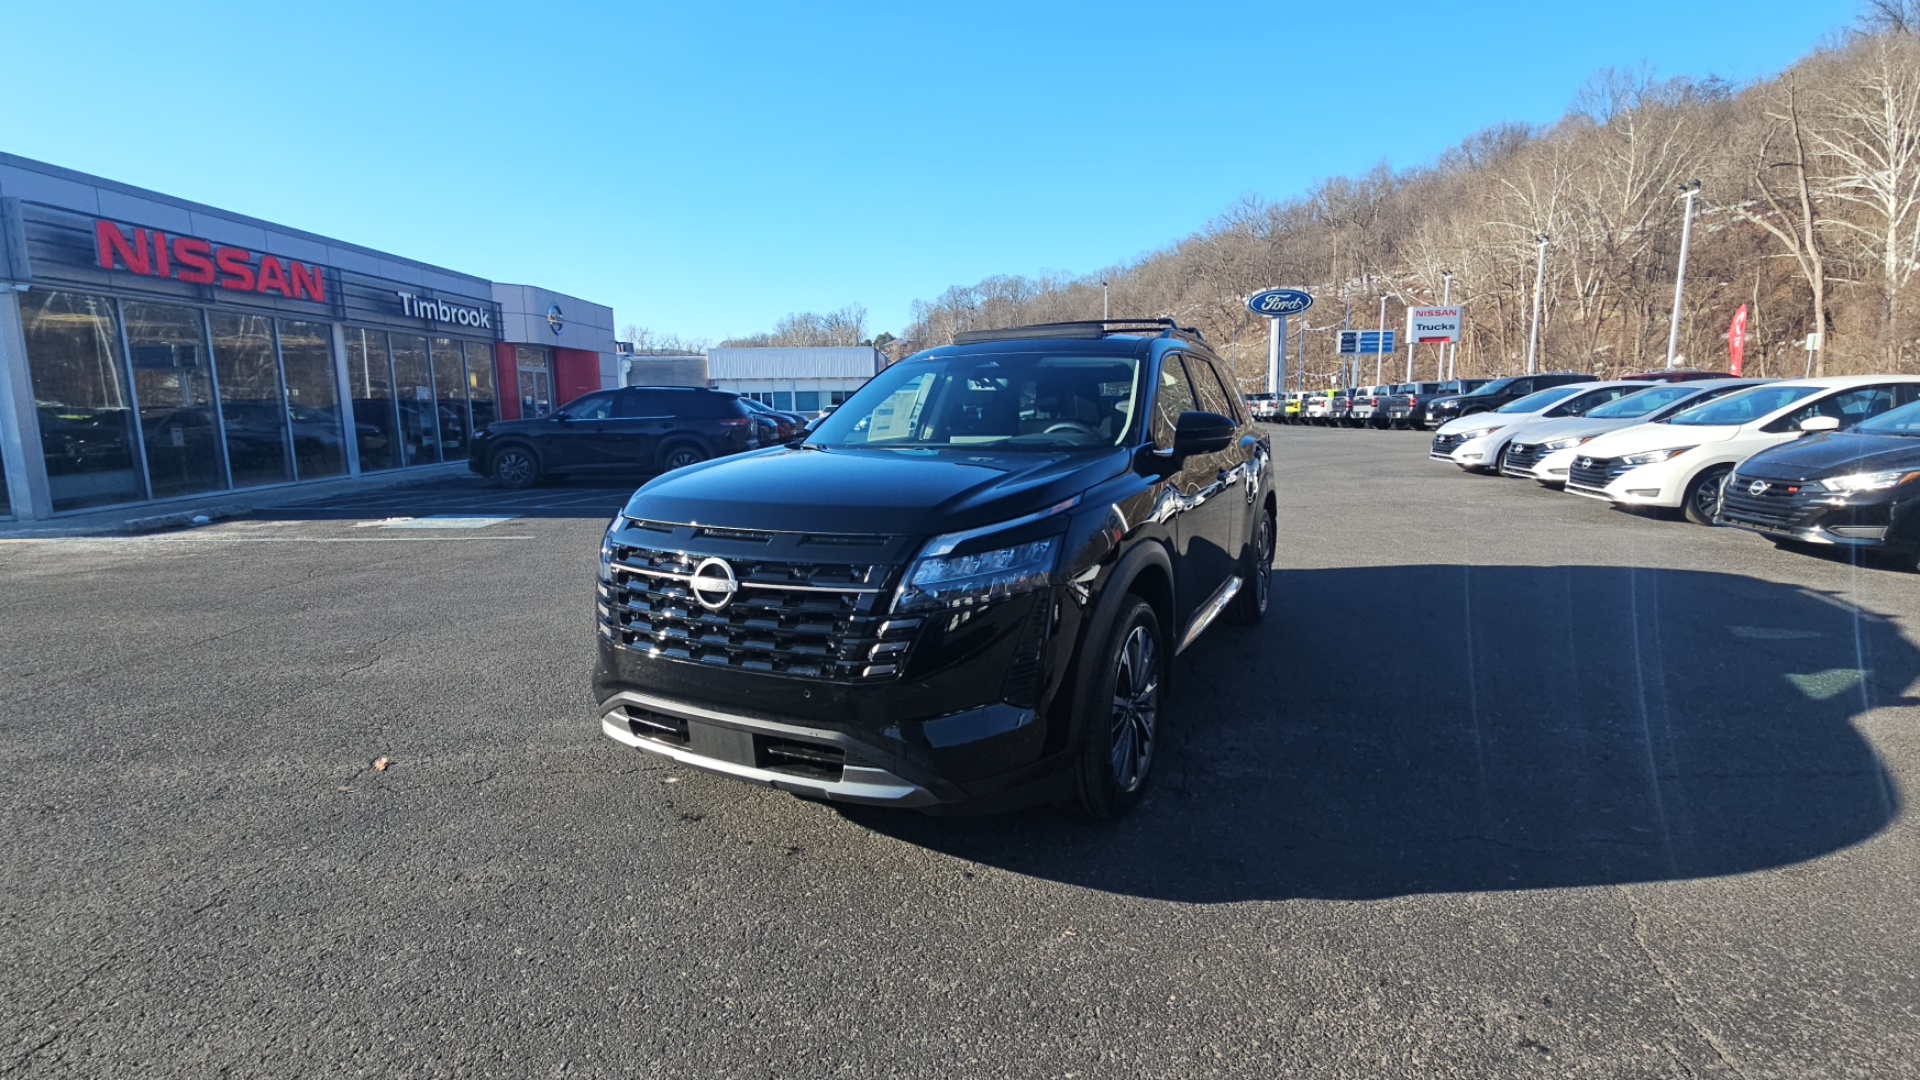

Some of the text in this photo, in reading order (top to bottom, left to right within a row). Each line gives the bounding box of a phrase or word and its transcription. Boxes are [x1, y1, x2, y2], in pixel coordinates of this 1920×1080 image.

[96, 220, 325, 303] NISSAN
[398, 291, 490, 328] Timbrook
[1261, 294, 1302, 310] Ford
[1415, 309, 1457, 317] NISSAN
[1416, 323, 1455, 331] Trucks
[691, 577, 738, 592] NSAN
